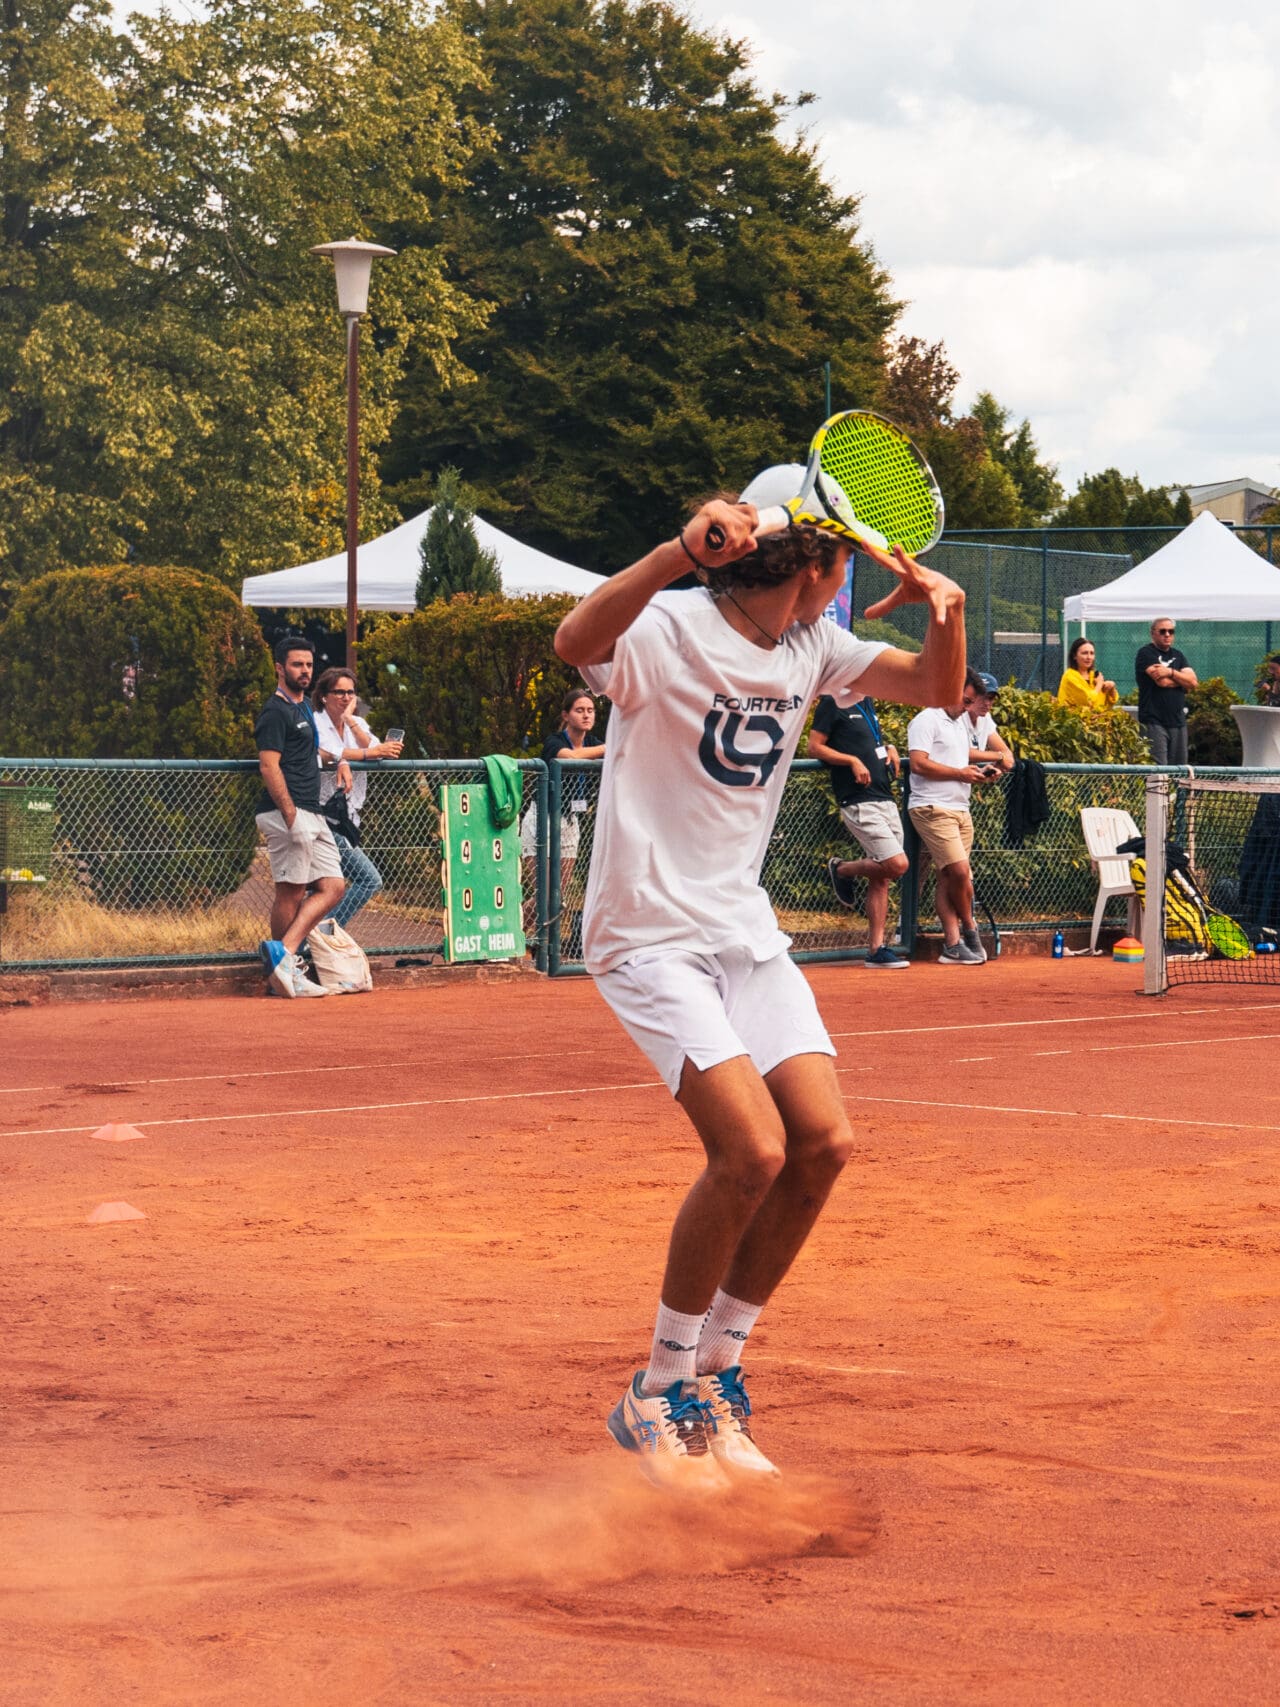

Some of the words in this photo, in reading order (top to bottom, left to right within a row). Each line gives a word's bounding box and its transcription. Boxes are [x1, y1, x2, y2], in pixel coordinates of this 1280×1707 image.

[460, 792, 470, 815] 6
[462, 840, 471, 862] 4
[494, 839, 503, 861] 3
[463, 888, 472, 910] 0
[495, 886, 504, 908] 0
[455, 934, 481, 952] GAST
[488, 933, 515, 950] HEIM
